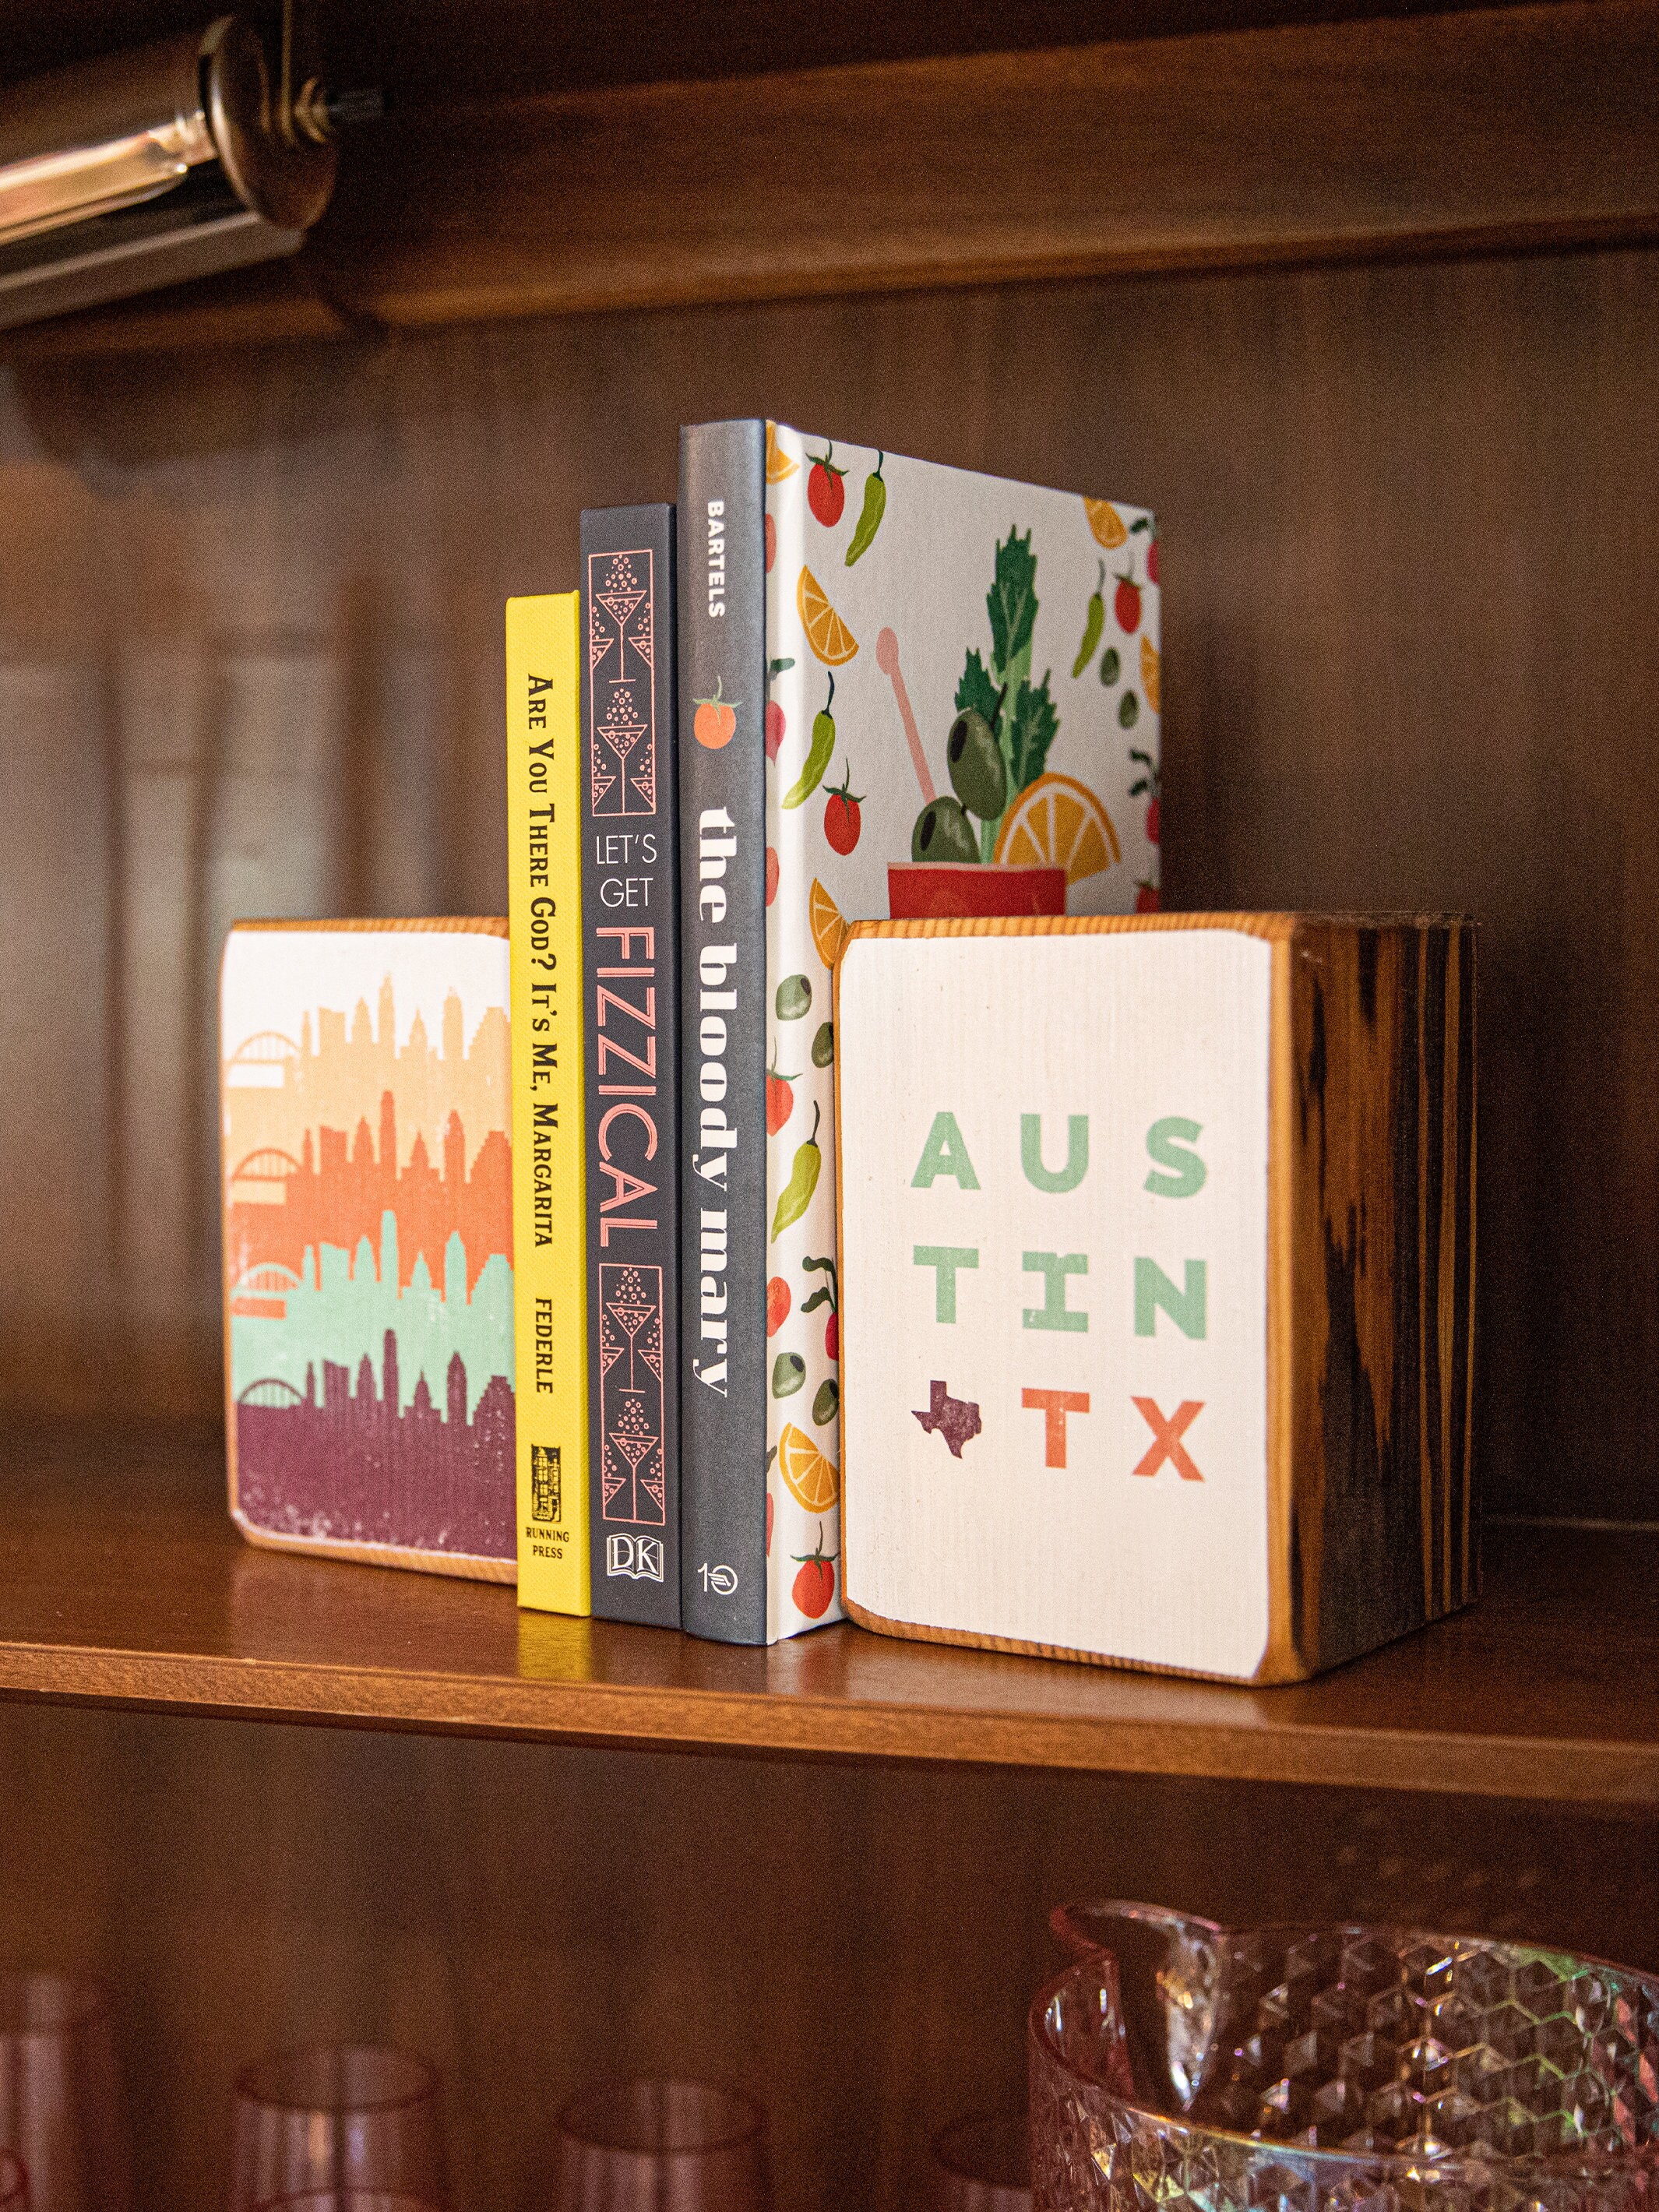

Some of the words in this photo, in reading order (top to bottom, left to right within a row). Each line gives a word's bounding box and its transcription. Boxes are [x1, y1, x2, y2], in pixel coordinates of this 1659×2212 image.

[707, 500, 726, 618] BARTELS
[596, 833, 657, 865] LET'S
[600, 878, 653, 907] GET
[699, 806, 736, 923] the
[596, 927, 658, 1247] FIZZICAL
[692, 942, 737, 1192] bloody
[534, 1298, 553, 1394] FEDERLE
[692, 1209, 728, 1397] mary
[1022, 1389, 1206, 1481] TX
[526, 1527, 569, 1543] RUNNING
[533, 1545, 562, 1559] PRESS
[611, 1536, 658, 1574] DK
